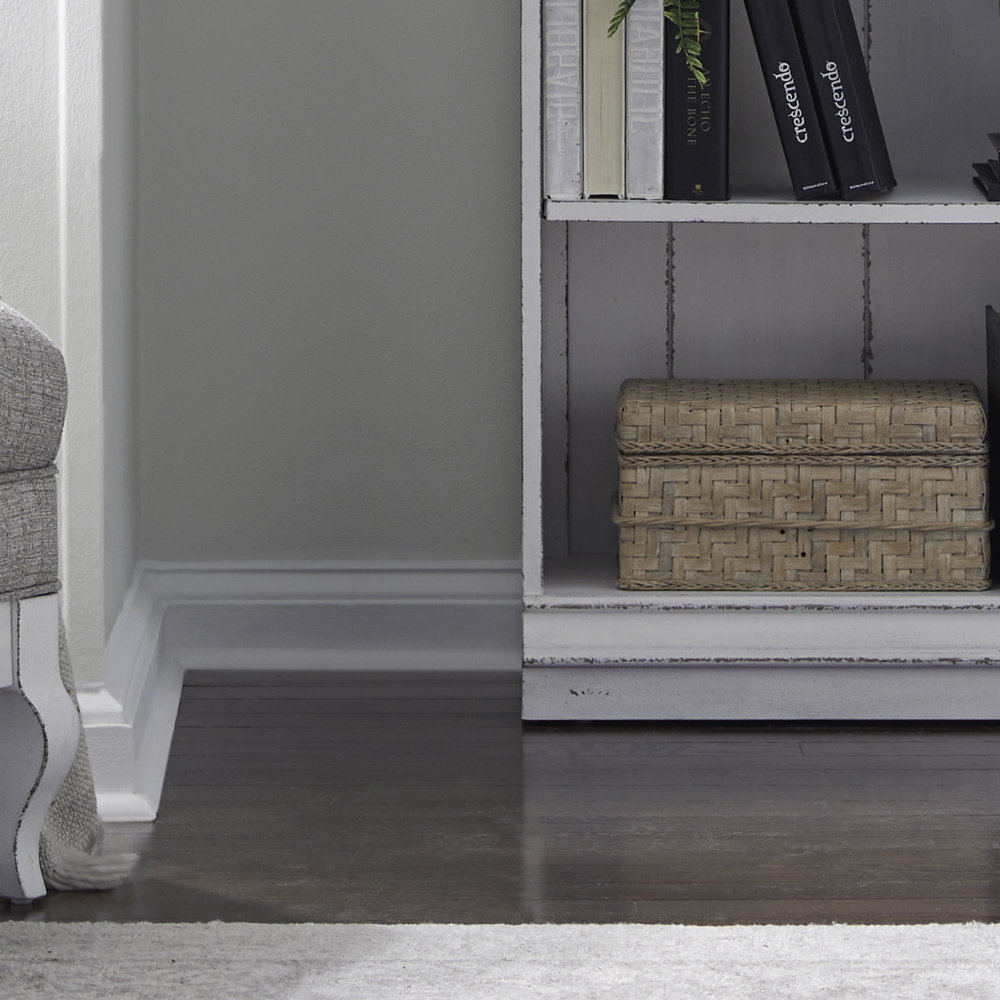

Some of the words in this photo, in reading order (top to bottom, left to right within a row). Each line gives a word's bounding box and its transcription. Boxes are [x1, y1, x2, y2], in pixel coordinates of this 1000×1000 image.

[687, 109, 696, 146] BONE
[701, 93, 710, 132] ECHO
[773, 62, 808, 144] crescendo
[820, 61, 854, 143] crescendo
